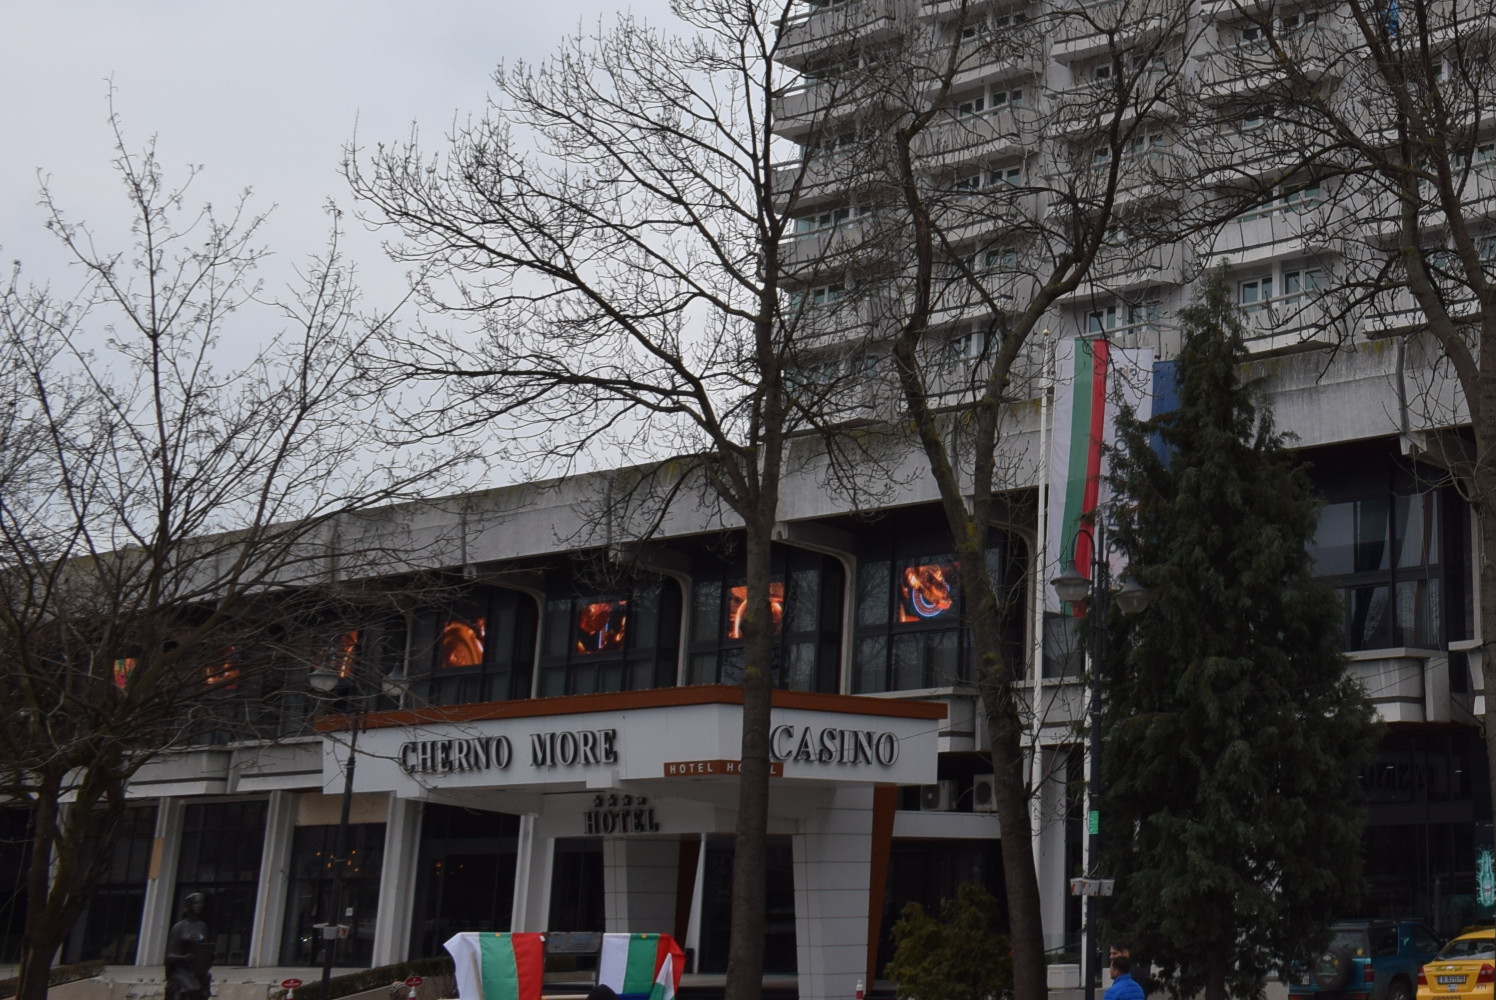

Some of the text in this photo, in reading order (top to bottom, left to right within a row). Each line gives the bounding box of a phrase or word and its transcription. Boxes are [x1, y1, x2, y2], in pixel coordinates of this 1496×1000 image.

[399, 729, 618, 773] CHERNO MORE
[770, 724, 900, 767] CASINO
[669, 762, 776, 775] HOTEL HOL
[584, 808, 660, 834] HOTEL
